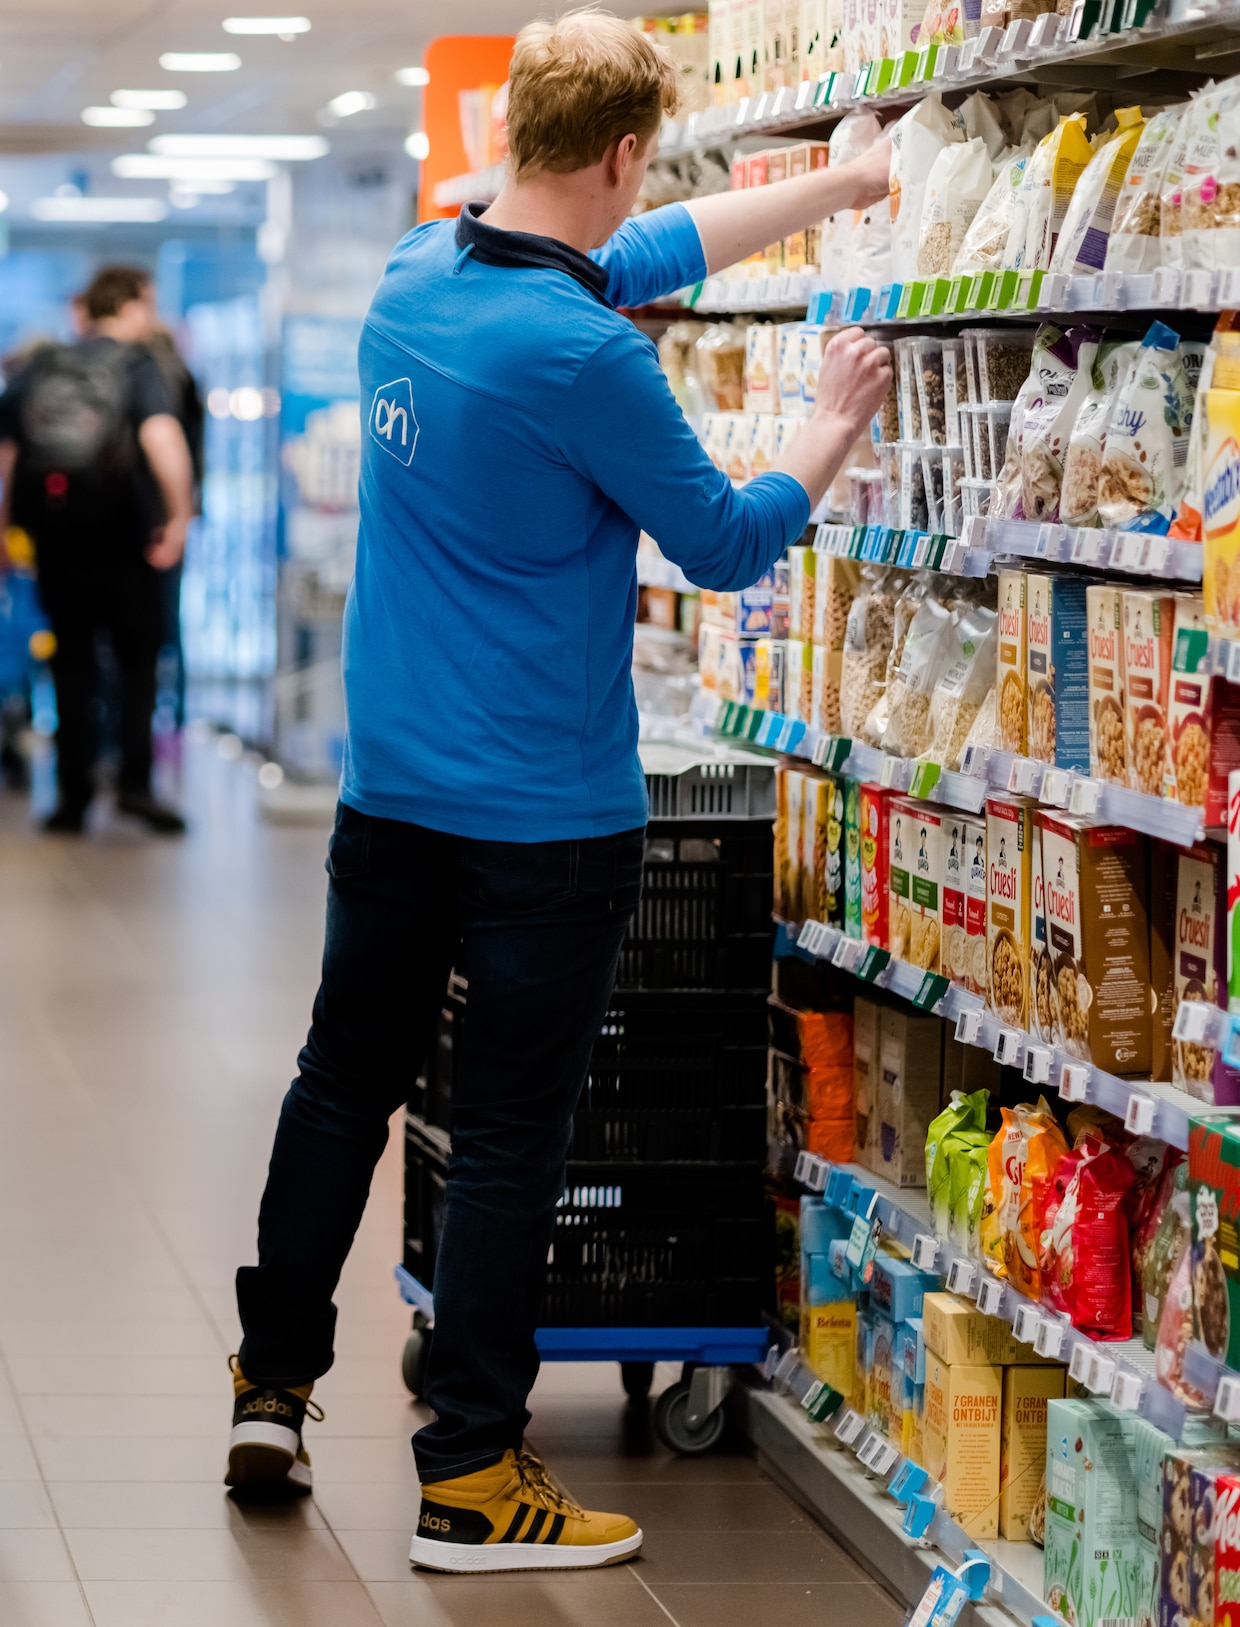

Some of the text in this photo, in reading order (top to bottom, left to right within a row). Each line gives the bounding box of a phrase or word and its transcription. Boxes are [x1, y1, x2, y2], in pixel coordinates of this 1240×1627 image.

[998, 607, 1019, 637] Cruesli
[1029, 614, 1048, 645] Cruesli
[1091, 628, 1114, 661] Cruesli
[1127, 636, 1155, 669] Cruesli
[990, 863, 1016, 900] Cruesli
[1047, 881, 1075, 925] Cruesli
[1179, 907, 1210, 949] Cruesli
[816, 1315, 852, 1328] Brinta
[242, 1397, 292, 1417] adidas
[954, 1395, 998, 1408] 7 GRANEN
[1016, 1398, 1047, 1409] 7 GRAN
[953, 1408, 998, 1422] ONTBIJT
[1015, 1410, 1047, 1423] ONTBI
[421, 1512, 451, 1532] das
